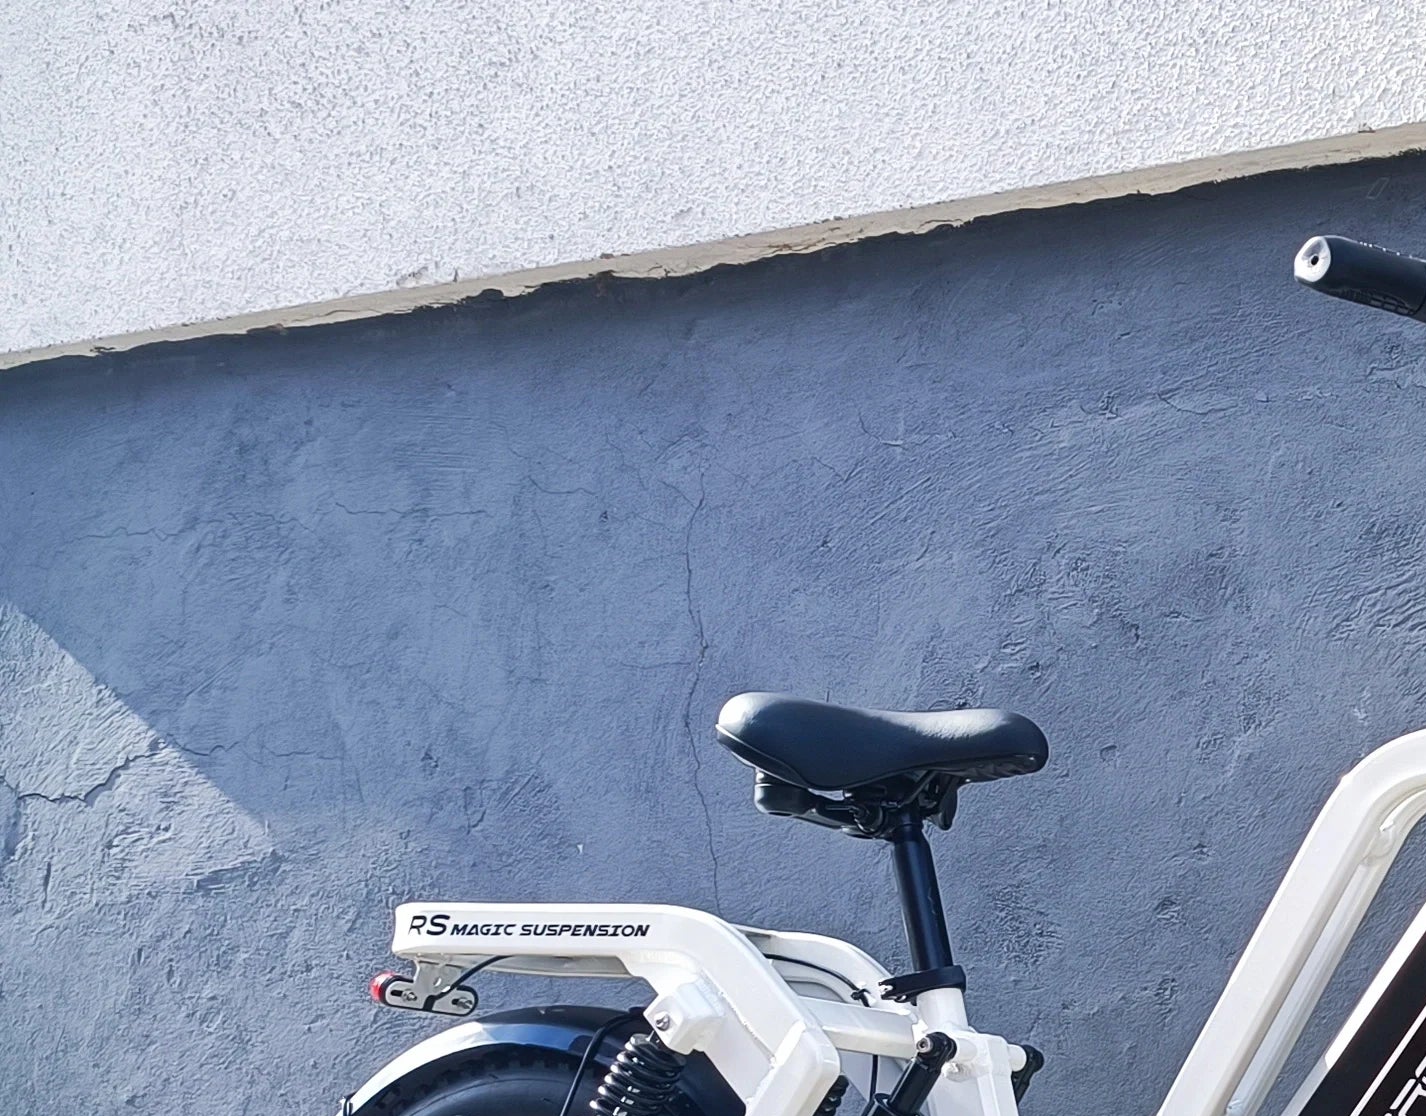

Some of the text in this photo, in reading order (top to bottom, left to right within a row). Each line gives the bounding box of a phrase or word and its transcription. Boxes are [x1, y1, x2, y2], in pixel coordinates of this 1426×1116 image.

[408, 914, 651, 937] RS MAGIC SUSPENSION
